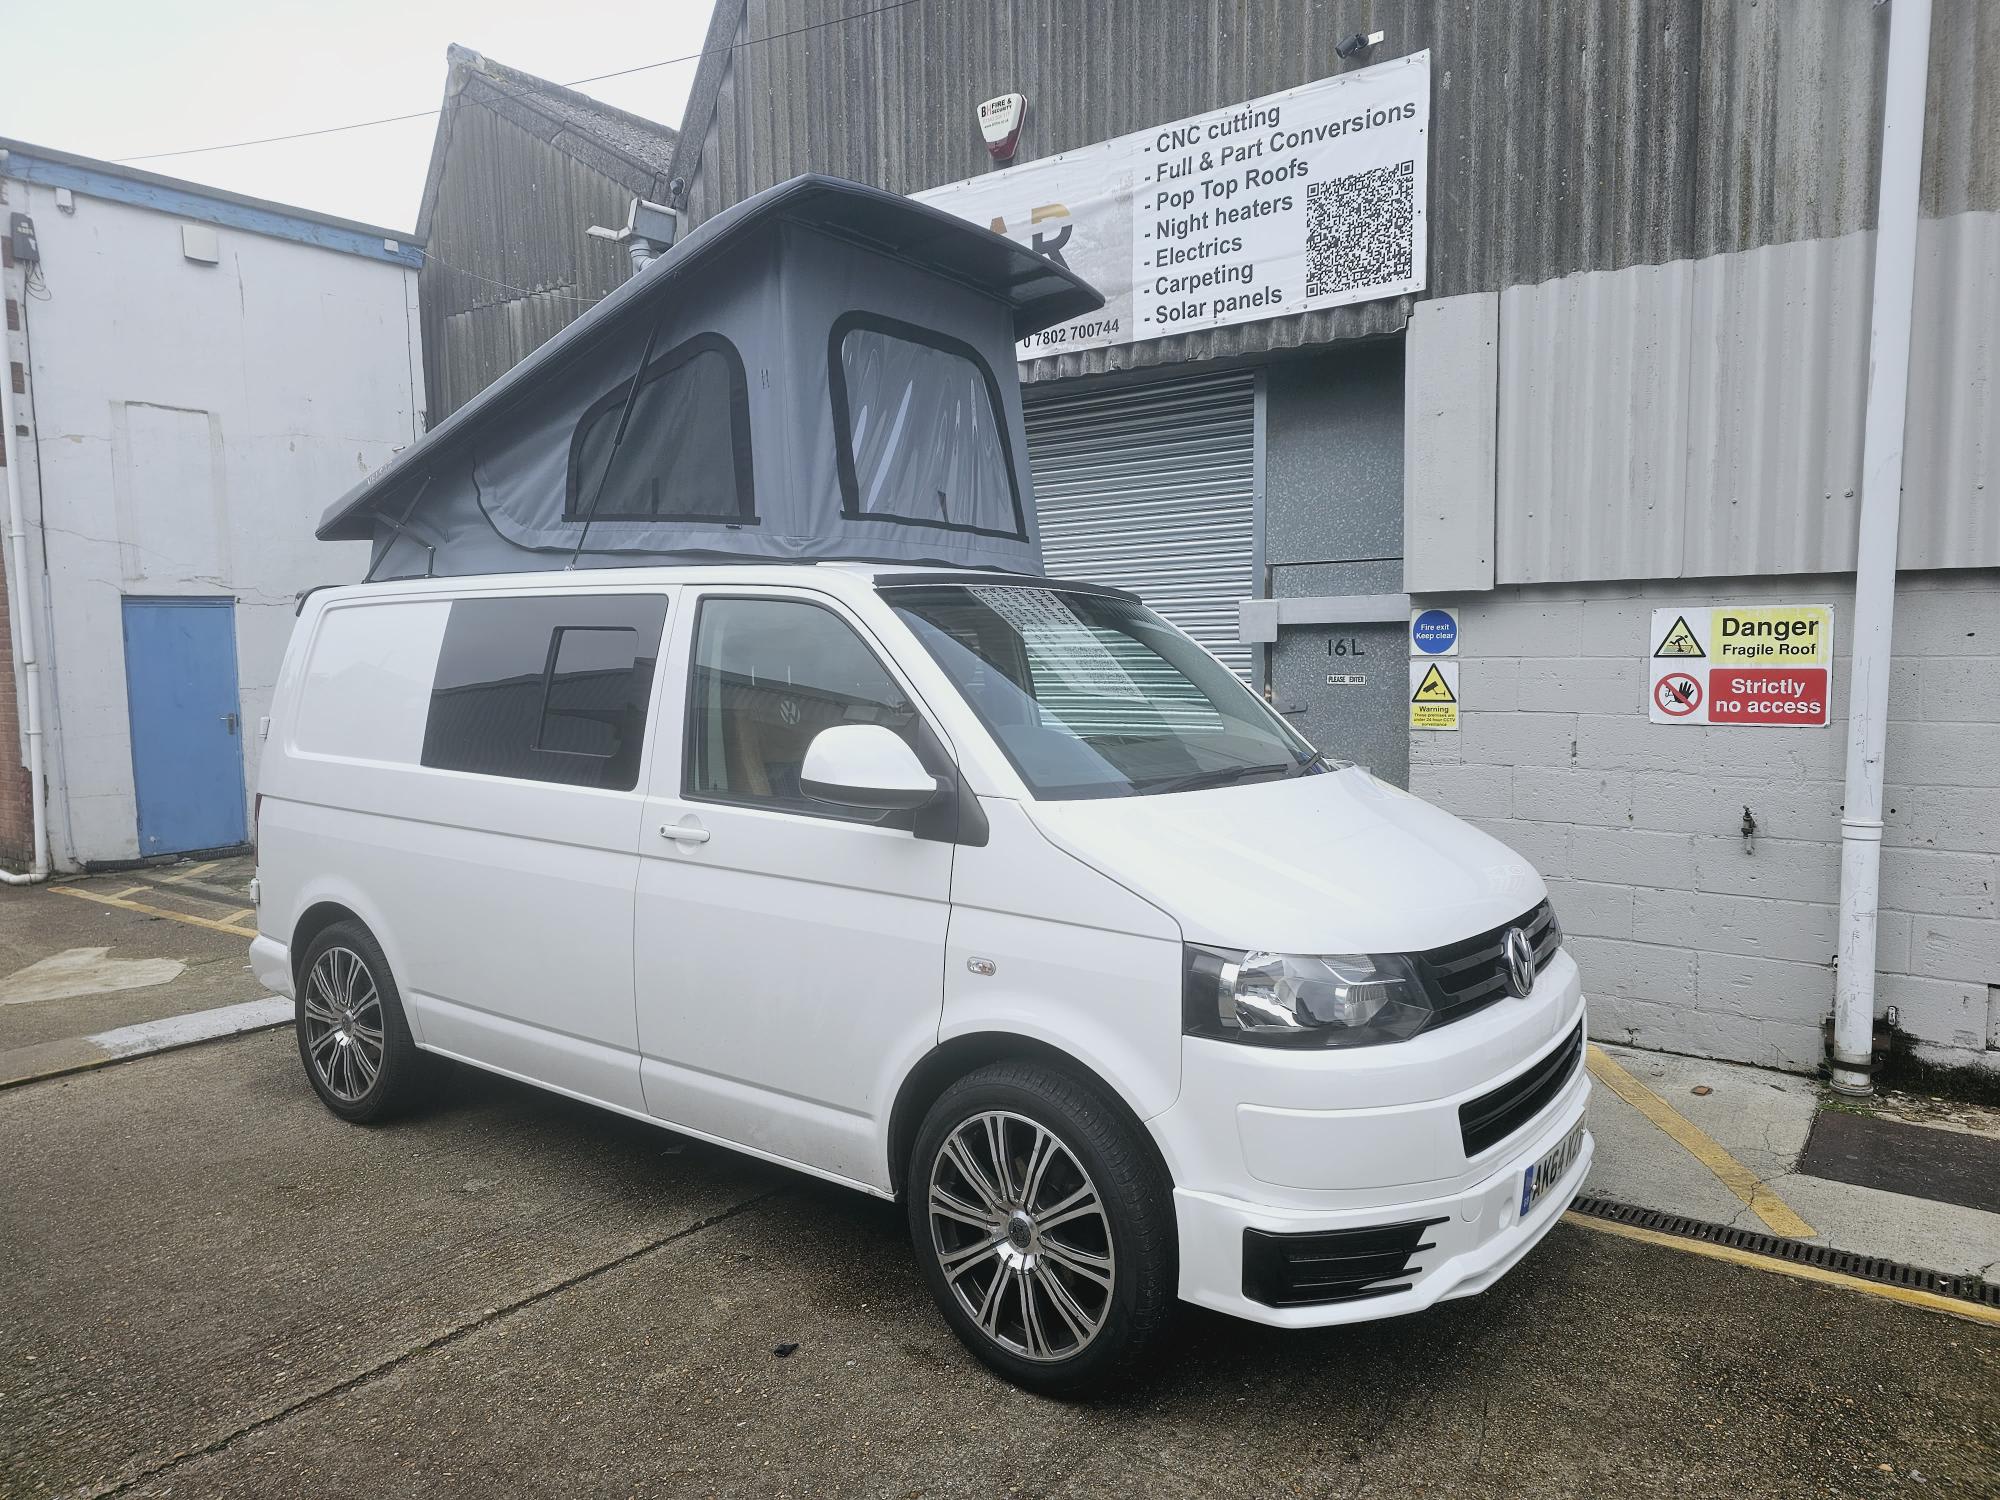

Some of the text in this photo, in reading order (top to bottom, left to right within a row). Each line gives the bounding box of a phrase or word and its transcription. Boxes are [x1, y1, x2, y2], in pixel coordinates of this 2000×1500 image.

[992, 100, 1005, 109] FIRE
[992, 105, 1012, 114] SECURITY
[1156, 126, 1200, 152] CNC
[1208, 106, 1280, 140] cutting
[1156, 156, 1192, 182] Full
[1199, 152, 1214, 170] &
[1221, 140, 1263, 166] Part
[1270, 102, 1416, 152] Conversions
[1157, 186, 1194, 211] Pop
[1200, 178, 1238, 200] Top
[1245, 158, 1309, 190] Roofs
[1156, 211, 1208, 240] Night
[1215, 195, 1293, 226] heaters
[1156, 236, 1243, 268] Electrics
[1155, 264, 1254, 296] Carpeting
[1156, 301, 1206, 324] Solar
[1214, 286, 1283, 318] panels
[1035, 328, 1066, 346] 7802
[1070, 318, 1120, 340] 700744
[1416, 632, 1434, 640] Keep
[1722, 617, 1819, 641] Danger
[1722, 644, 1817, 658] Fragile Roof
[1731, 678, 1806, 697] Strictly
[1419, 706, 1449, 714] Warning
[1716, 700, 1821, 714] no access
